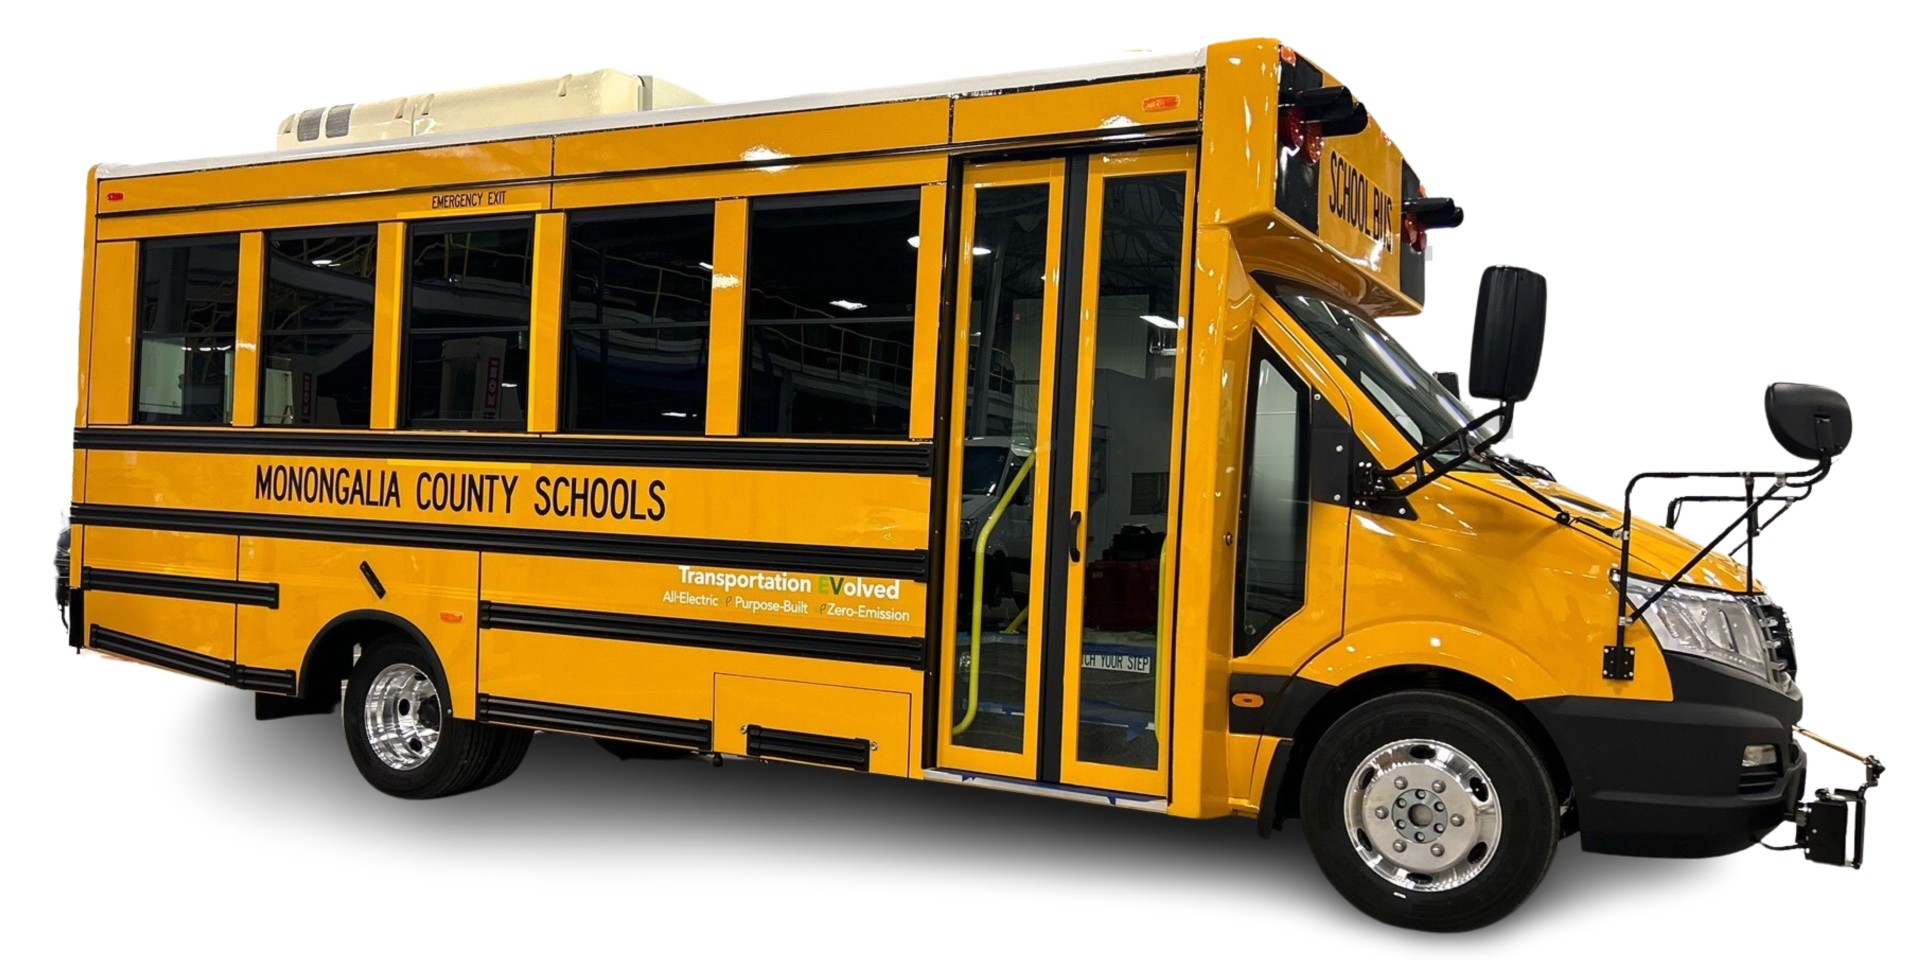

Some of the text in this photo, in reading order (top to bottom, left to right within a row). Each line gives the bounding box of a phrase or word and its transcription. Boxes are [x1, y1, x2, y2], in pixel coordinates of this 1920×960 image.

[432, 190, 507, 209] EMERGENCY EXIT
[1329, 151, 1392, 253] SCHOOL BUS
[255, 464, 666, 521] MONONGALIA COUNTY SCHOOLS
[678, 565, 900, 600] Transportation EVolved
[662, 590, 910, 621] All-Electric Purpose-Built Zero-Emission
[1101, 655, 1123, 669] YOUR
[1127, 656, 1149, 671] STEP
